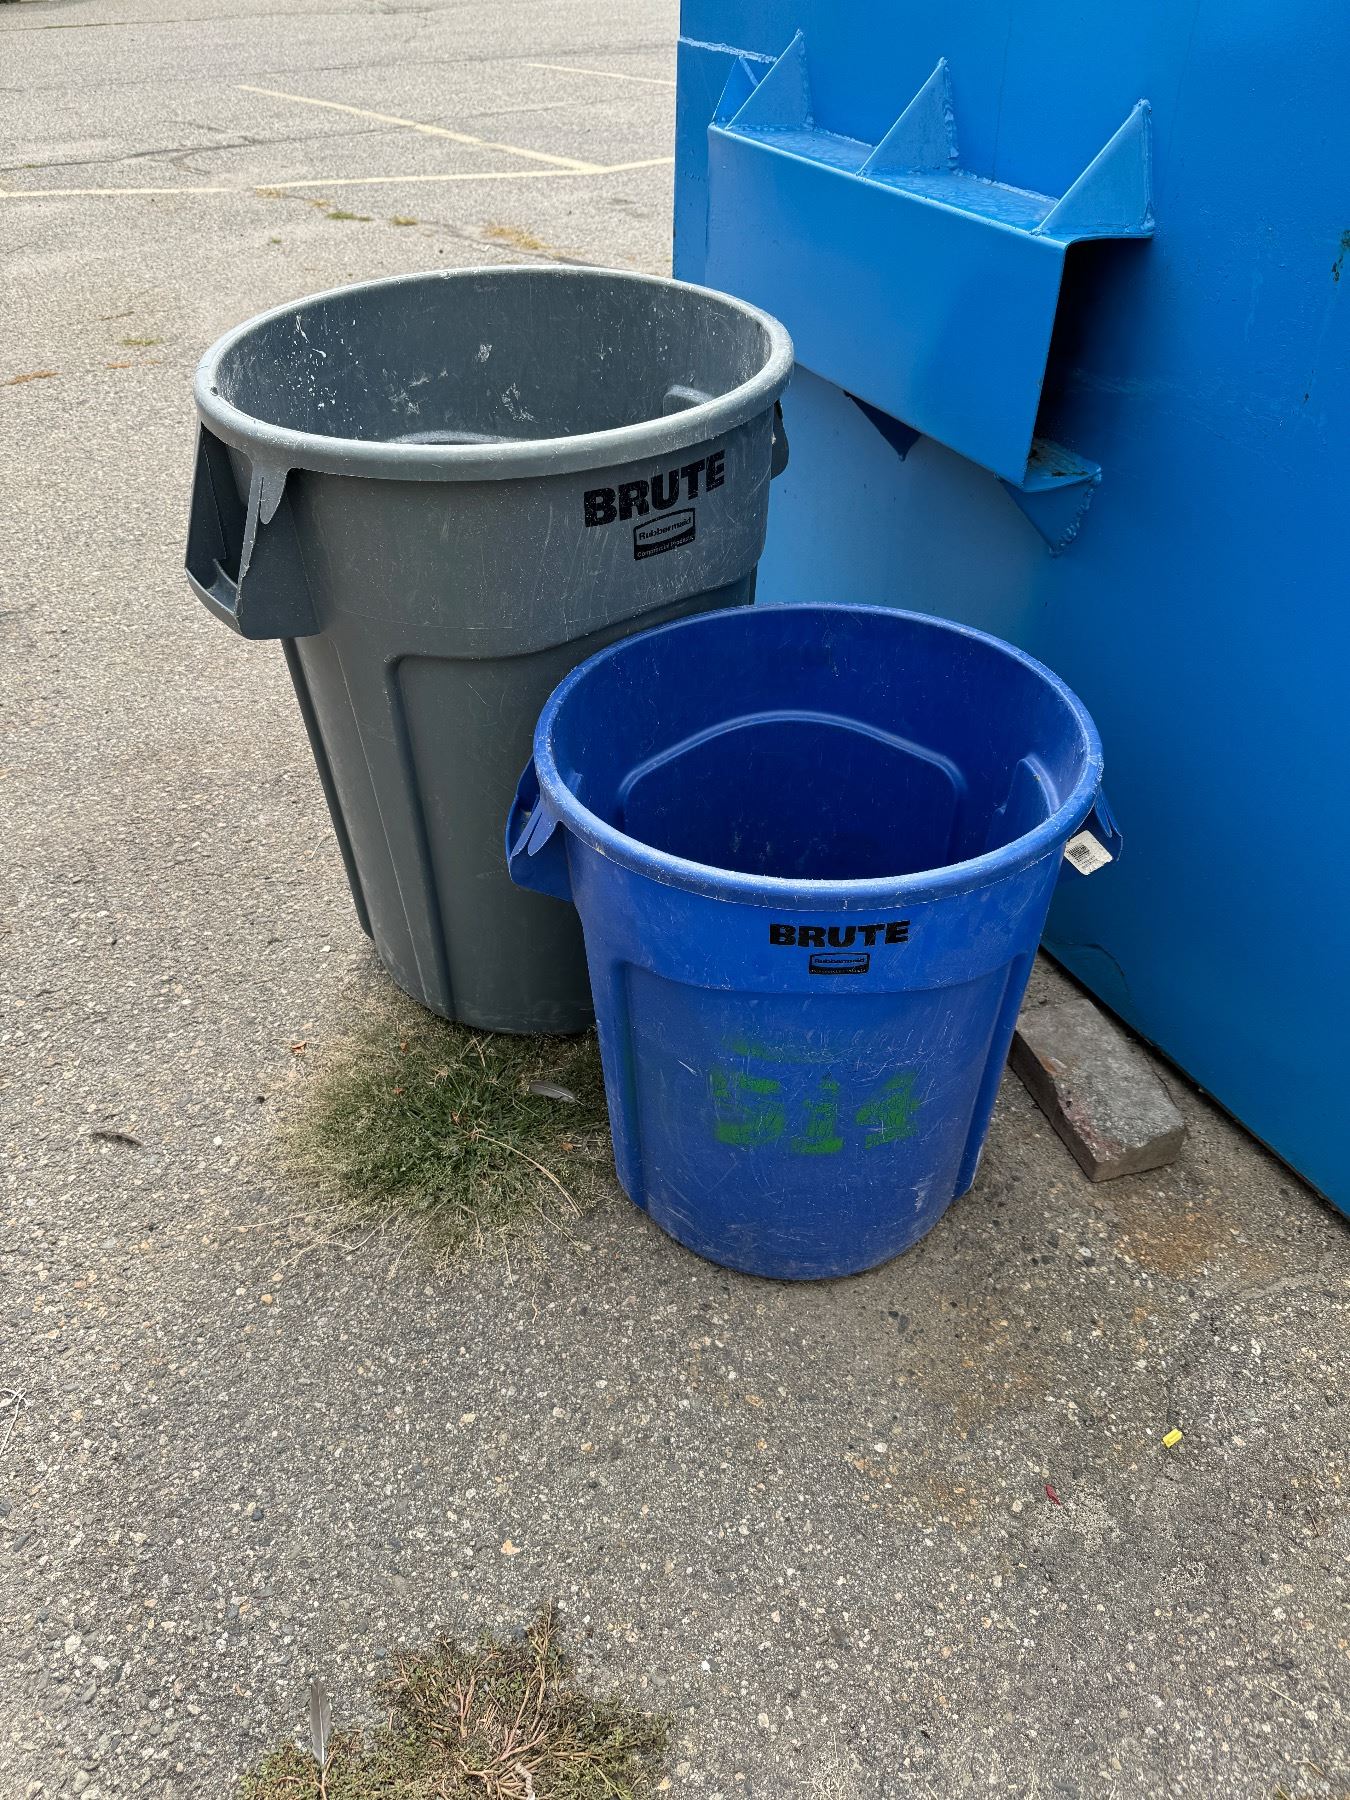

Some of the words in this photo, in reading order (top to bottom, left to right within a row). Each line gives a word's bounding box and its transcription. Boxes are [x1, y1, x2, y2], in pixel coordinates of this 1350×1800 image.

[584, 450, 725, 527] BRUTE
[639, 517, 692, 541] Rubbermaid
[769, 920, 911, 948] BRUTE
